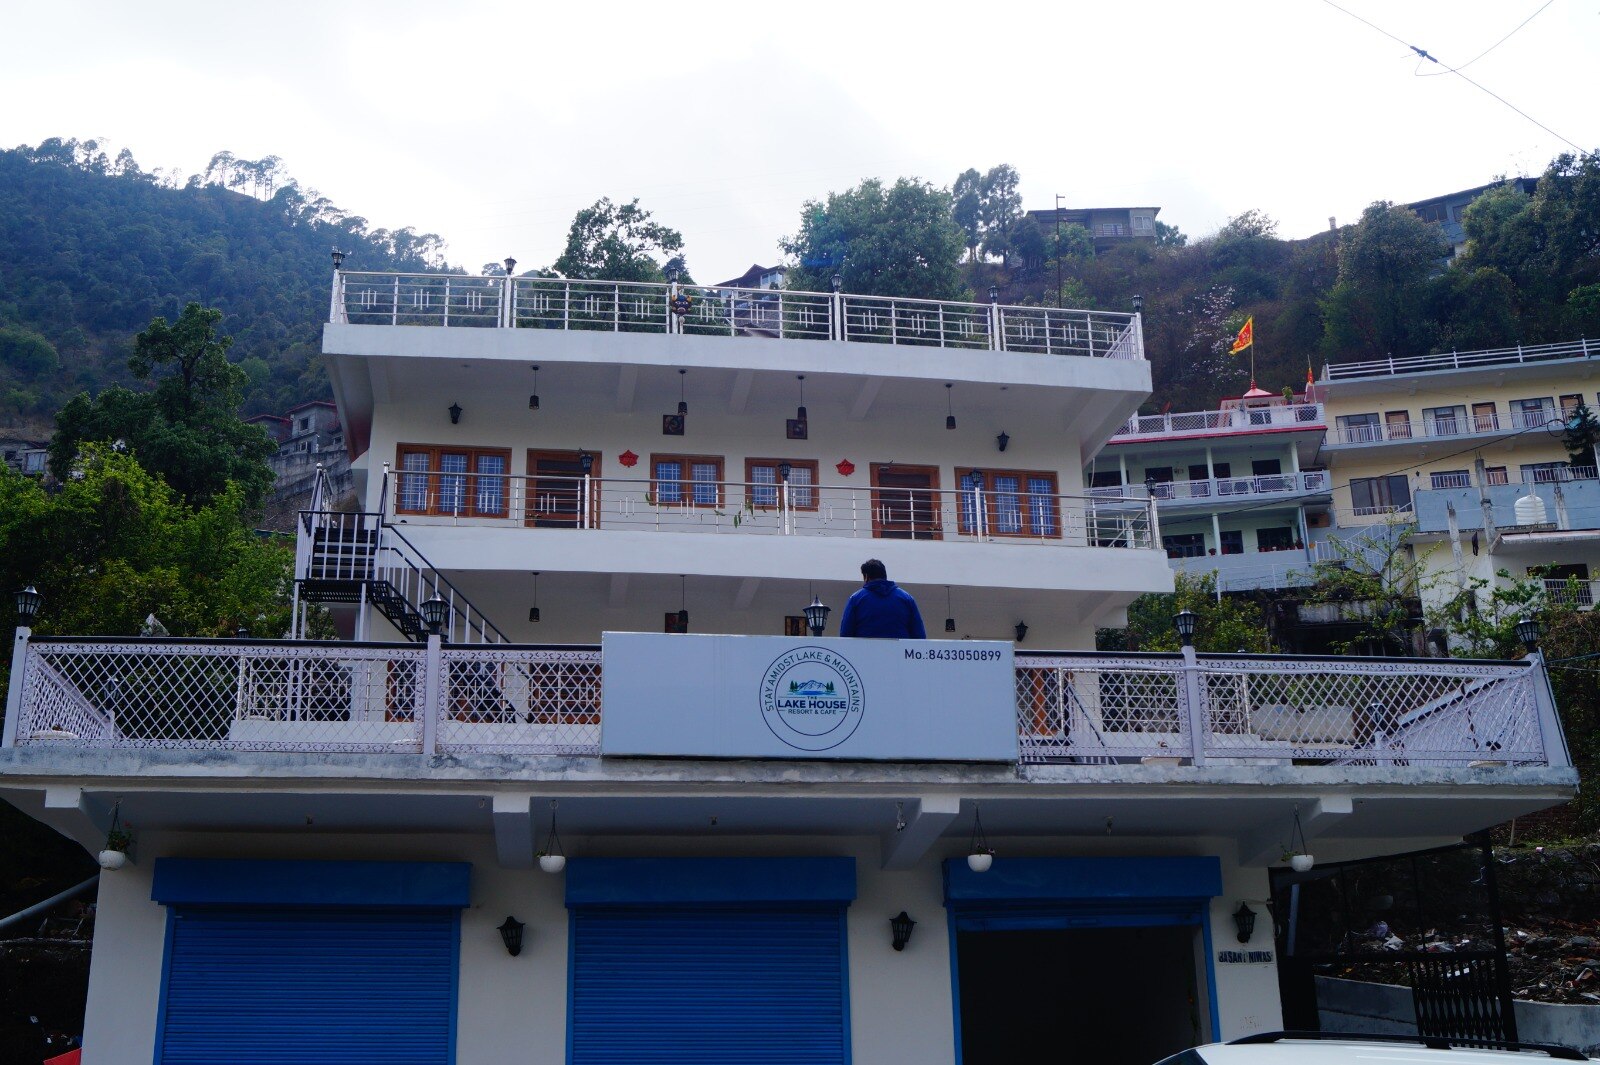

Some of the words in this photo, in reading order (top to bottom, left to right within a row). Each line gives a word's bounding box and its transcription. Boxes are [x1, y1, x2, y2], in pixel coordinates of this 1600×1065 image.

[796, 651, 823, 661] LAKE
[824, 654, 831, 662] &
[904, 648, 1001, 661] Mo.:8433050899
[768, 655, 795, 686] AMIDST
[832, 658, 860, 713] MOUNTAINS
[764, 687, 774, 712] STAY
[778, 699, 806, 709] LAKE
[809, 700, 846, 709] HOUSE
[1248, 951, 1272, 963] NIWAS
